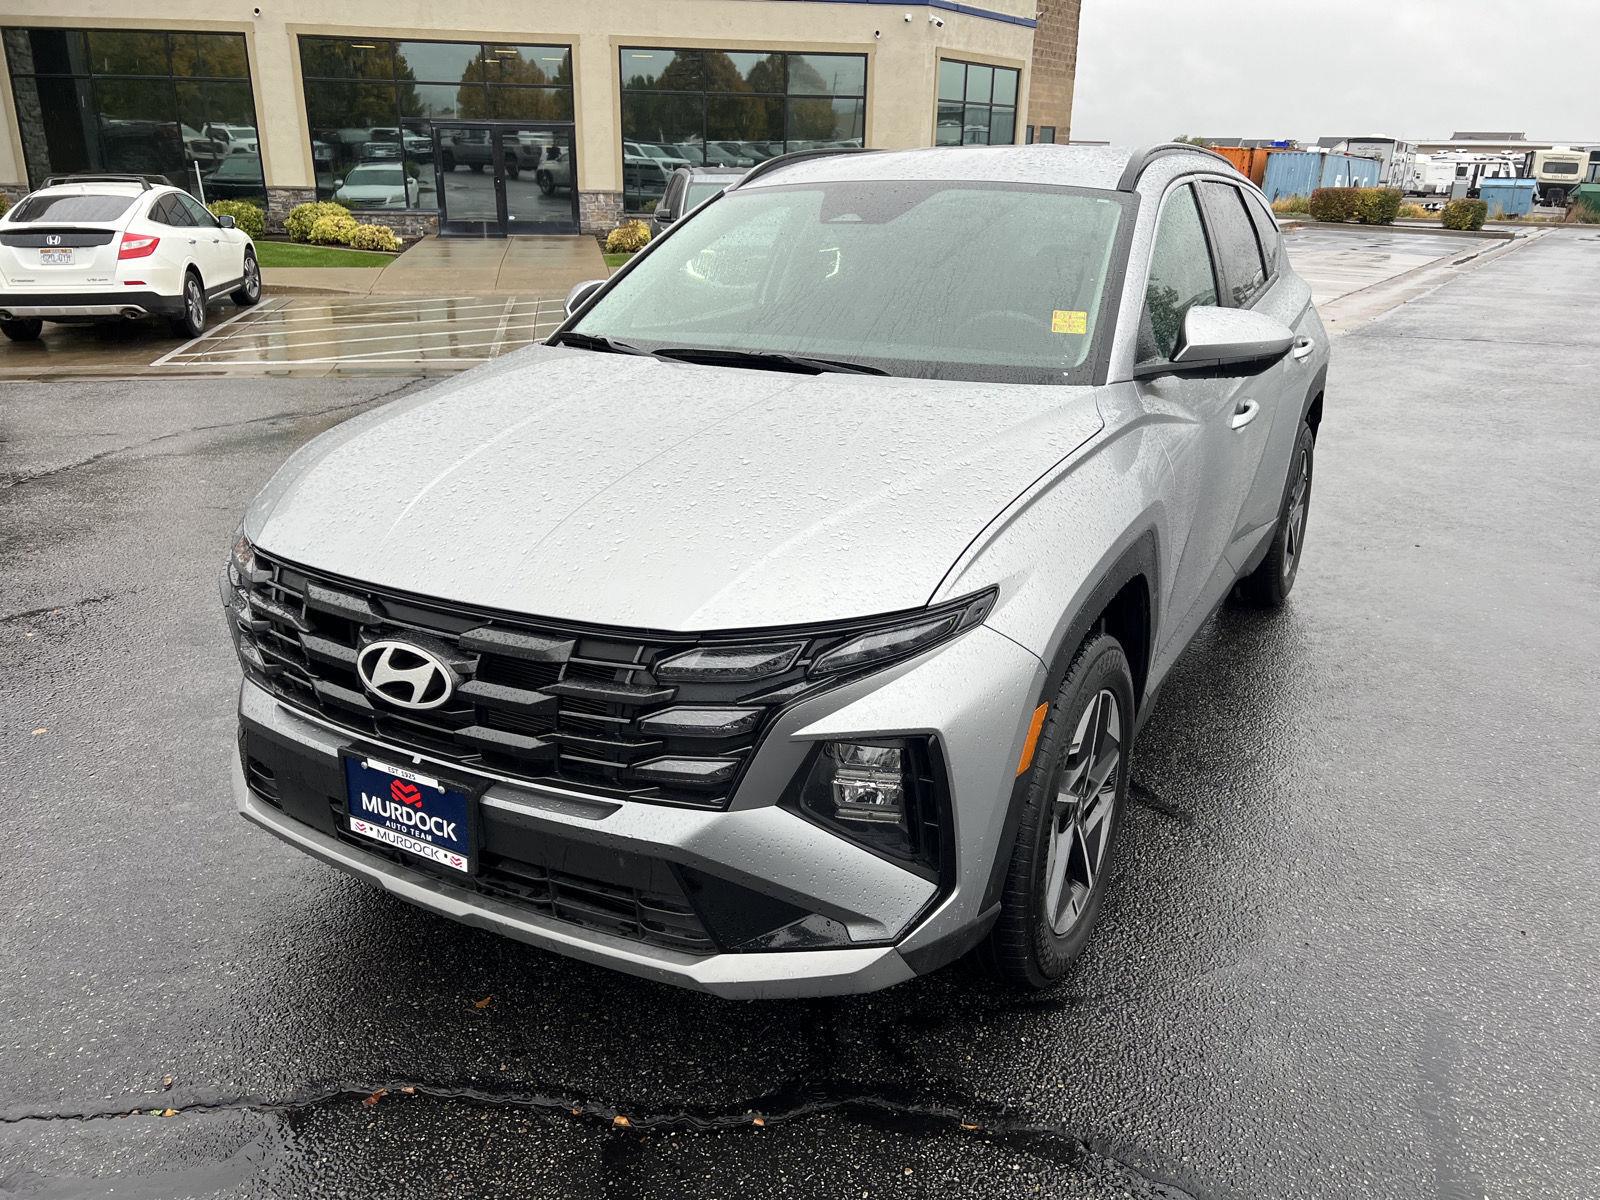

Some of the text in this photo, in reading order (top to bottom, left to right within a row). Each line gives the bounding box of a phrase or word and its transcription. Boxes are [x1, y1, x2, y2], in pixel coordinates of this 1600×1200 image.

[361, 792, 458, 842] MURDOCK
[385, 820, 432, 841] AUTO TEAM
[376, 828, 440, 860] MURDOCK
